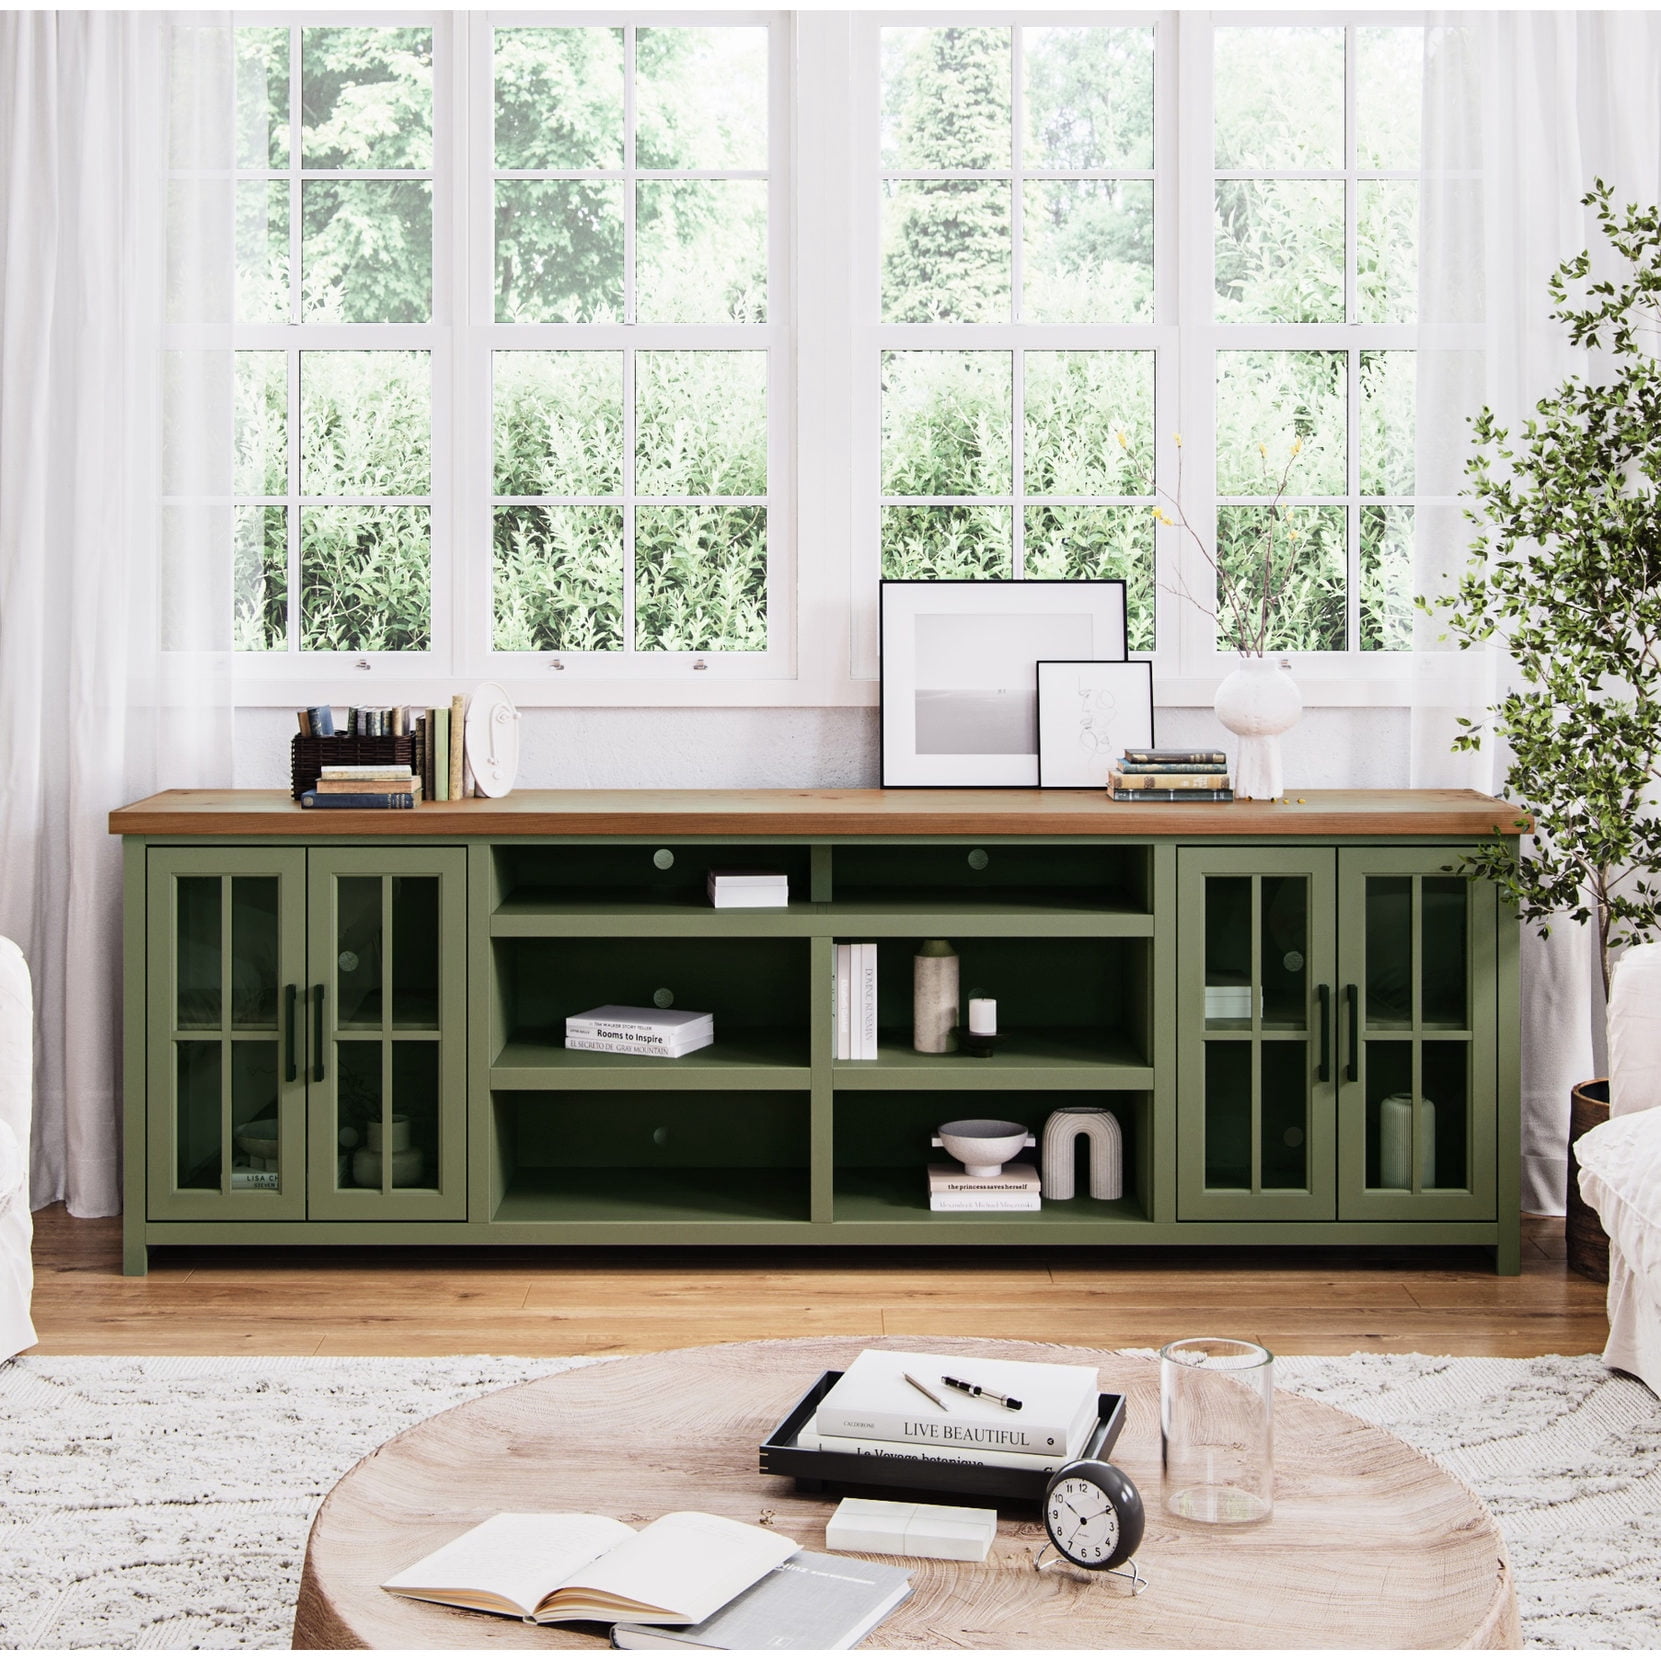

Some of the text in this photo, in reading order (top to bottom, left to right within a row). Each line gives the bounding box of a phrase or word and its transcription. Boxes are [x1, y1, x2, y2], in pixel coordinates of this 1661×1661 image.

[597, 1029, 623, 1039] Rooms
[636, 1034, 663, 1044] Inspire
[578, 1040, 604, 1049] SECRETO
[605, 1042, 613, 1050] DE
[616, 1043, 632, 1052] GRAY
[633, 1044, 668, 1055] MOUNTAIN
[904, 1422, 939, 1438] LIVE
[943, 1425, 1030, 1446] BEAUTIFUL
[1066, 1484, 1073, 1493] 11
[1079, 1483, 1088, 1493] 12
[1055, 1494, 1063, 1503] 10
[1052, 1510, 1058, 1519] 9
[1105, 1505, 1111, 1515] 2
[1057, 1526, 1063, 1536] 8
[1109, 1522, 1115, 1532] 3
[1067, 1540, 1073, 1550] 7
[1105, 1537, 1110, 1546] 4
[1081, 1548, 1087, 1558] 6
[1095, 1547, 1101, 1557] 5
